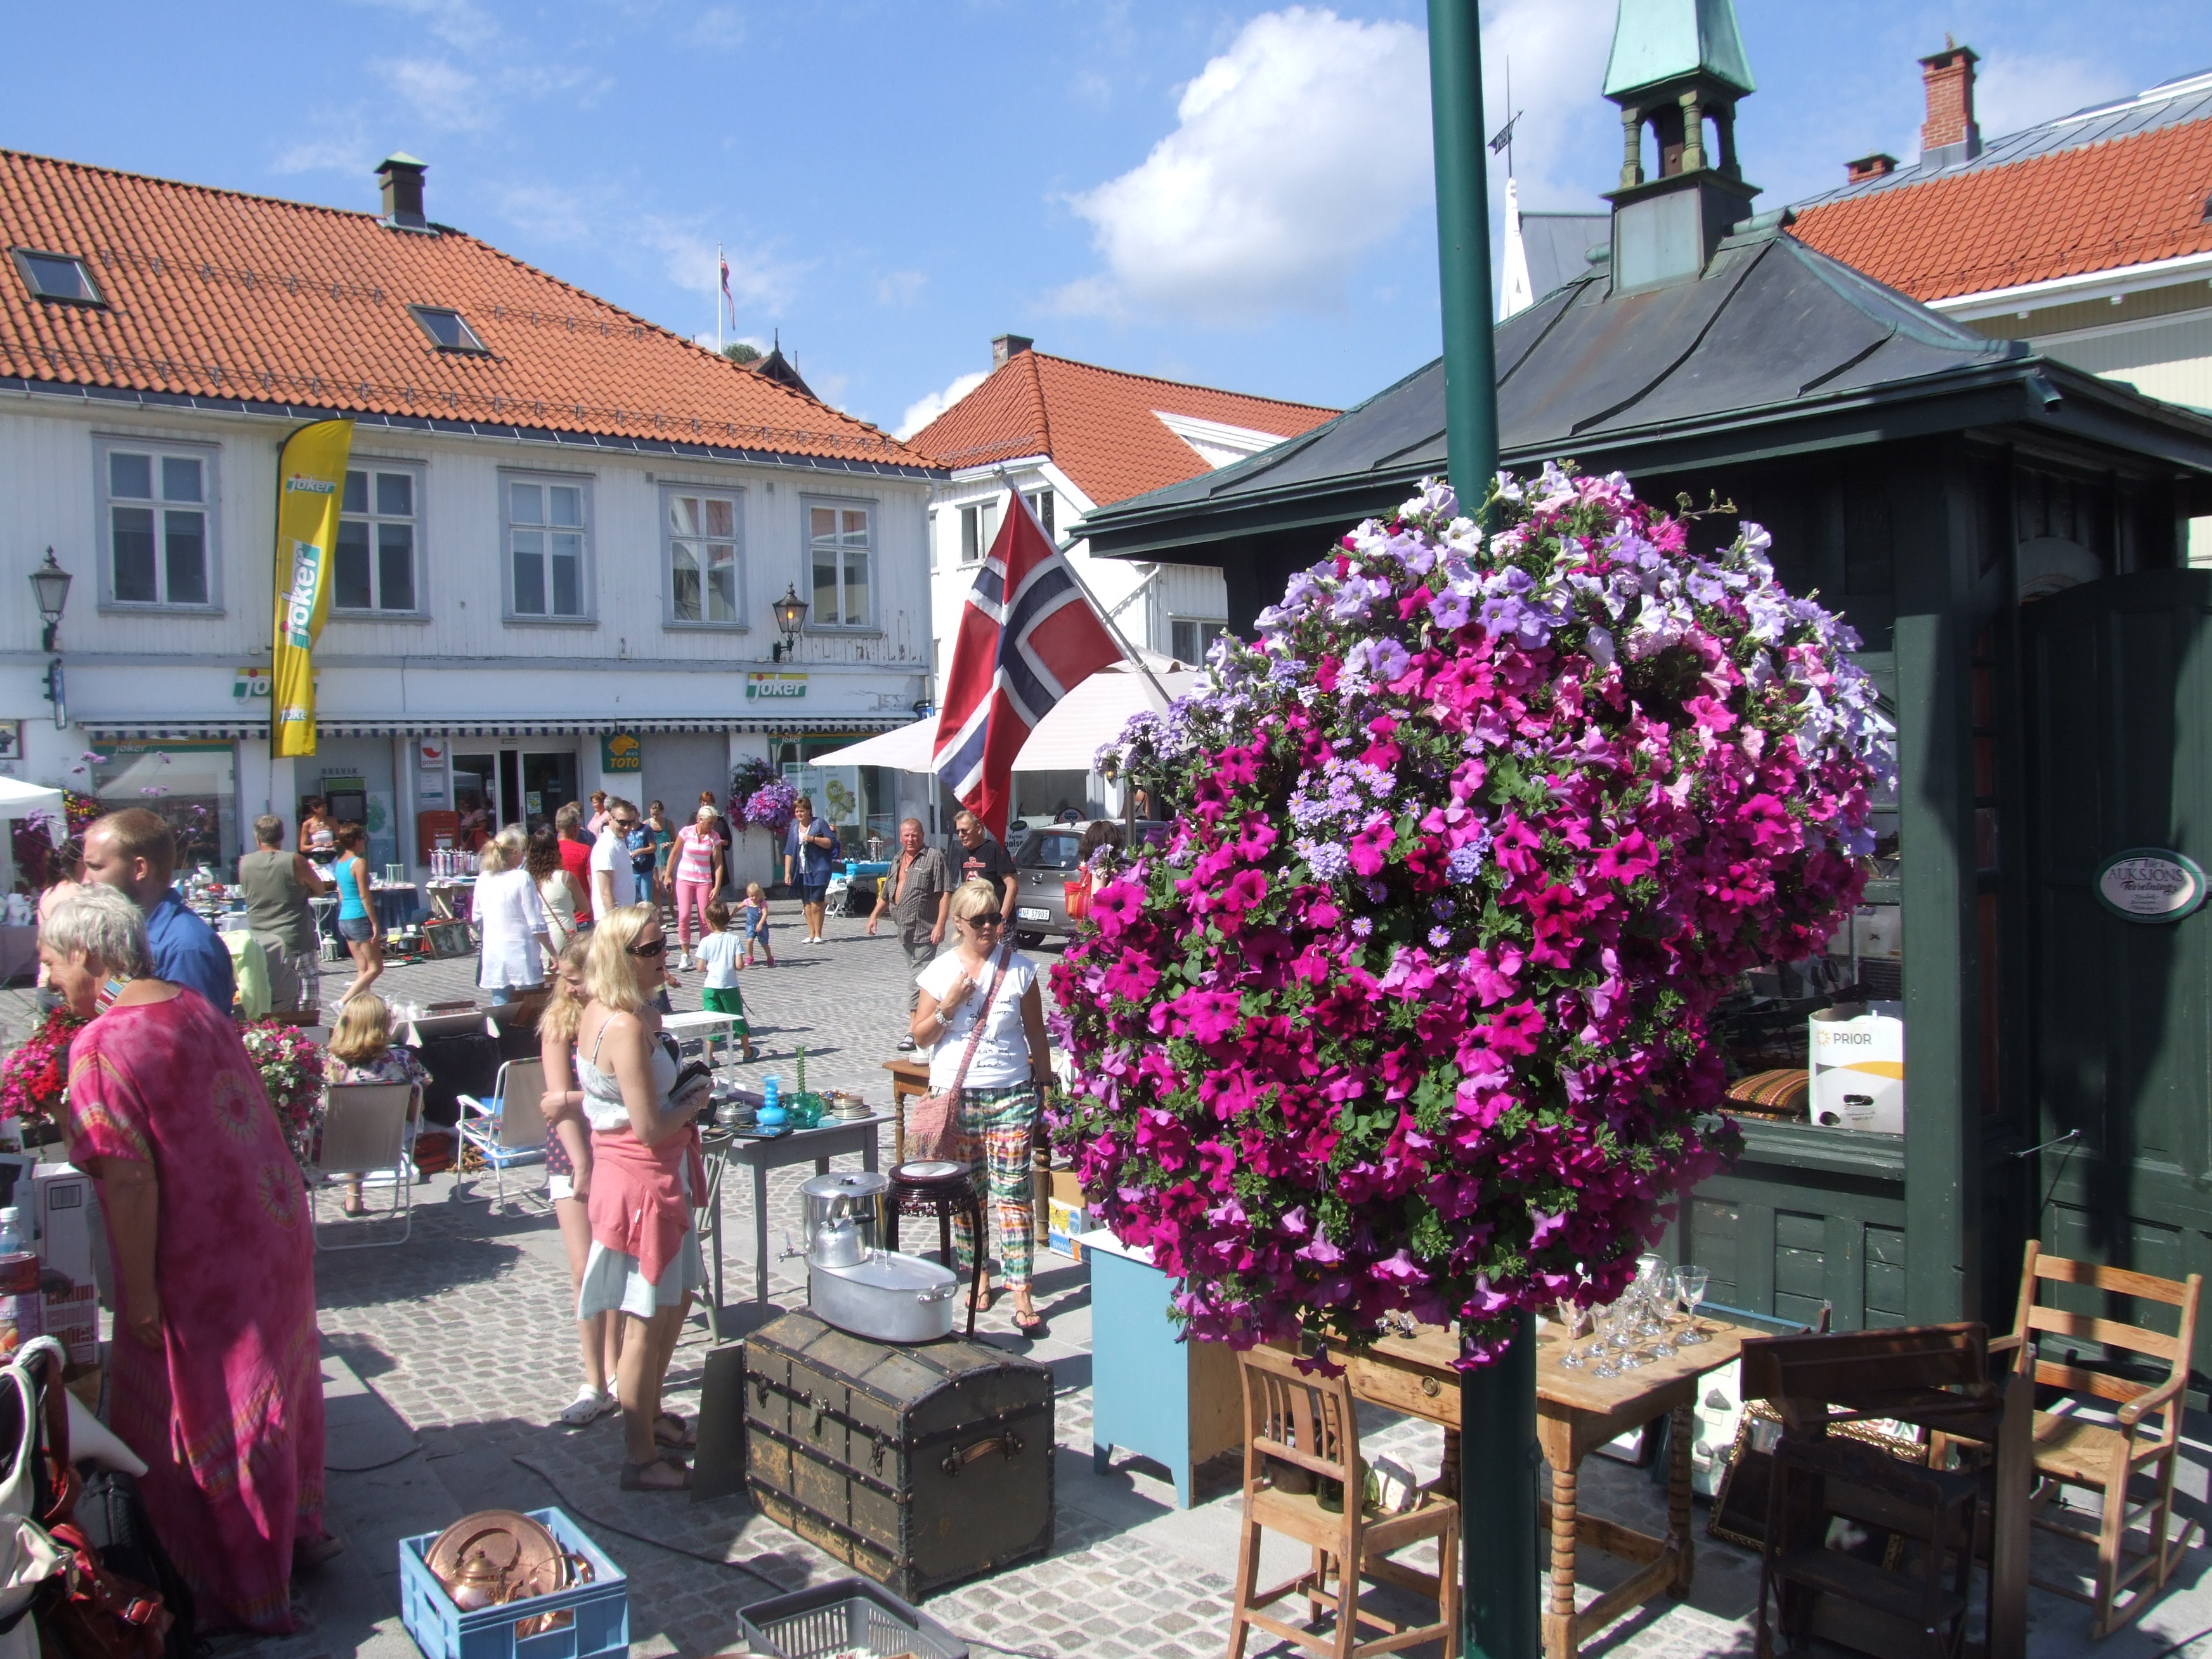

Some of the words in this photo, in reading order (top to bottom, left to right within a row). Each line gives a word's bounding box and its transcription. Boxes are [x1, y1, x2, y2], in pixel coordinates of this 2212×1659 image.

[287, 474, 335, 493] joker
[280, 547, 316, 644] joker
[750, 673, 805, 703] joker
[280, 705, 307, 725] joke
[781, 733, 802, 745] joker
[113, 740, 146, 755] joker
[610, 757, 639, 768] TOTO
[2107, 868, 2184, 882] AUKSJONS
[1031, 910, 1048, 919] 57905
[1833, 1032, 1872, 1045] PRIOR
